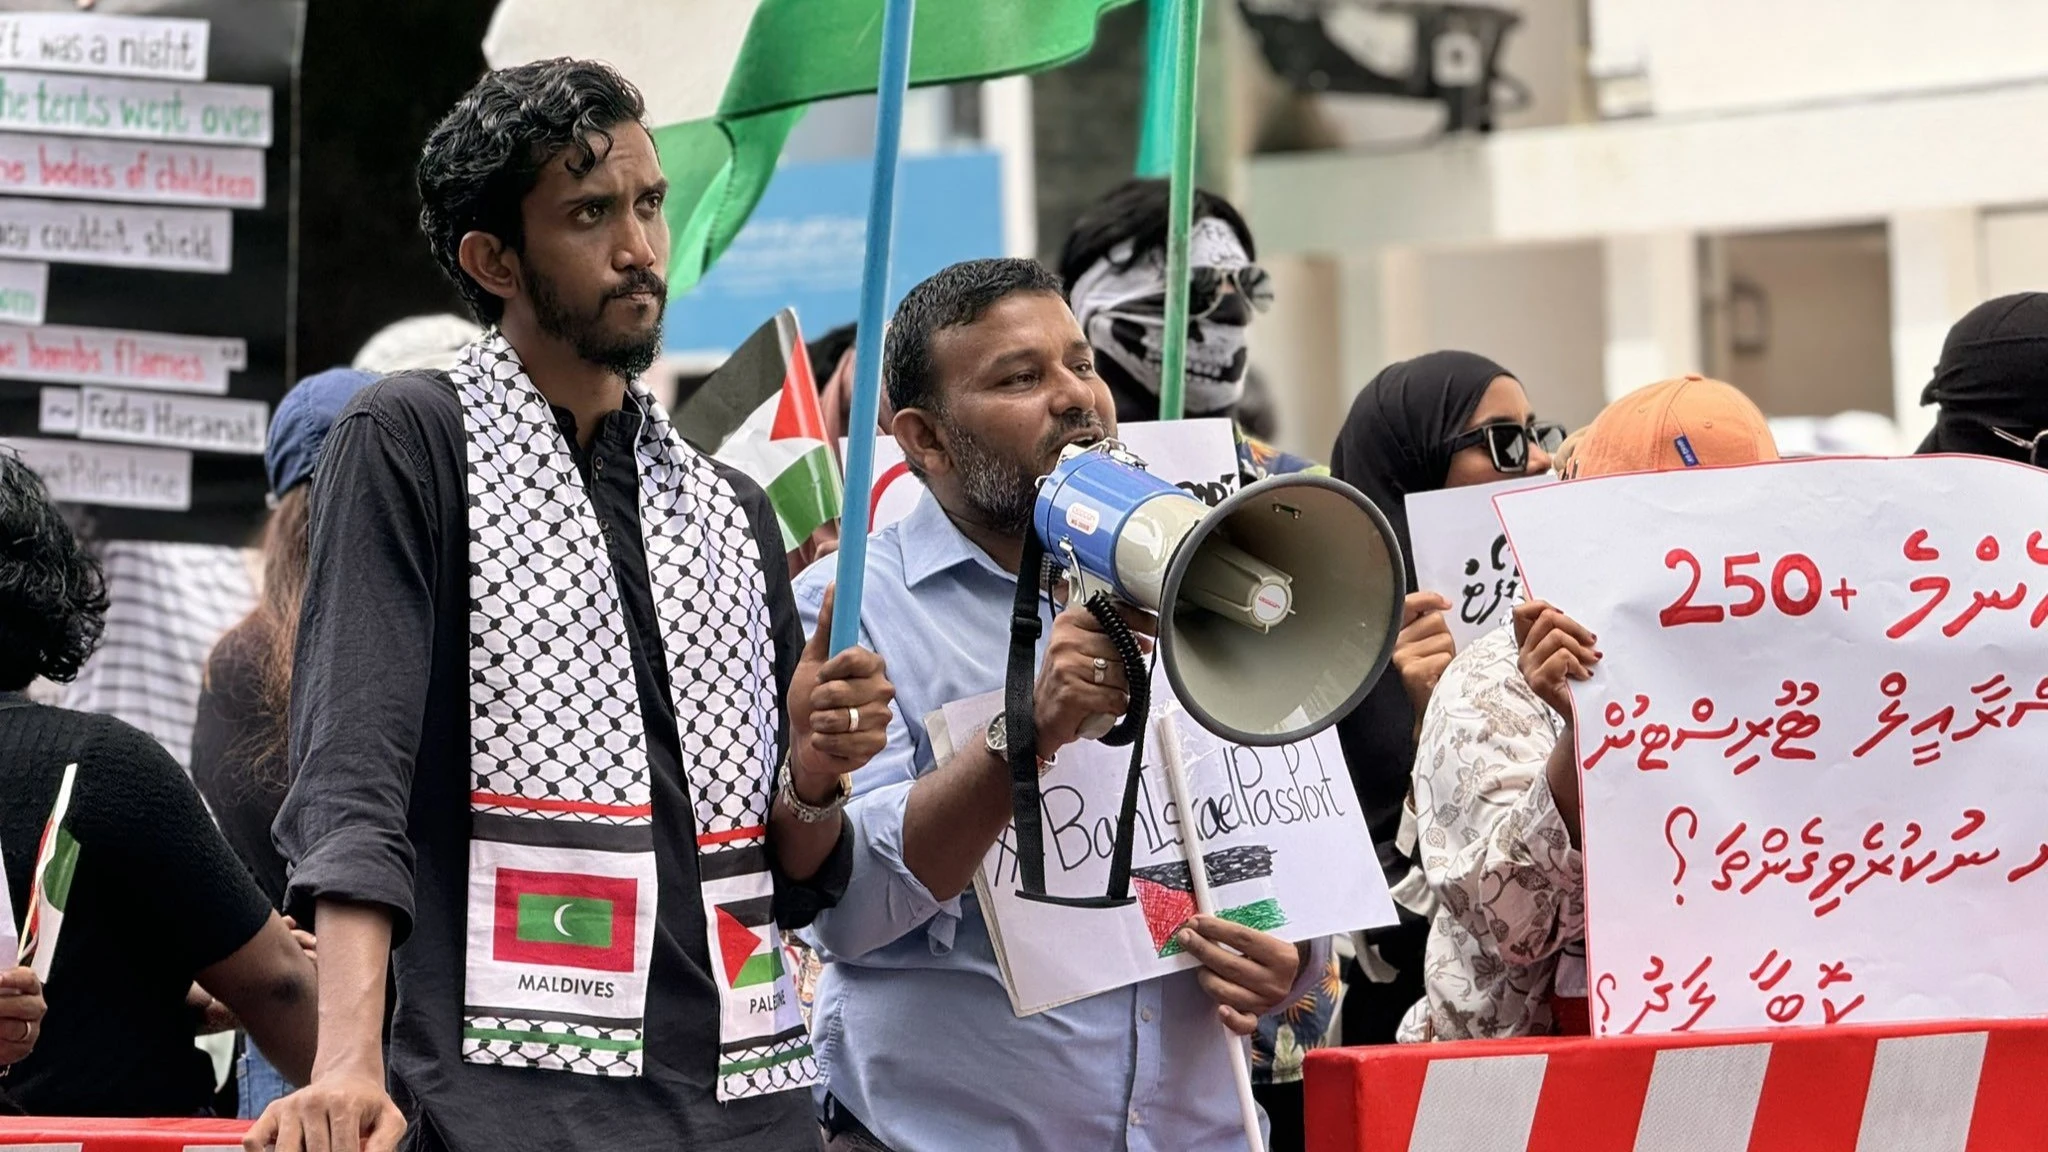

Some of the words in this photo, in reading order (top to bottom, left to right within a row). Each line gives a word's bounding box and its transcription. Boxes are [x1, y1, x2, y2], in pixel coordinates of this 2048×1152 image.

[40, 33, 84, 62] was
[88, 34, 107, 64] a
[119, 28, 196, 71] night
[36, 79, 111, 127] tents
[120, 90, 189, 135] wept
[202, 104, 265, 137] over
[38, 144, 116, 188] bodies
[125, 150, 148, 189] of
[155, 155, 256, 198] children
[144, 219, 213, 260] shield
[26, 331, 102, 371] bombs
[1659, 548, 1857, 627] 250+
[518, 974, 615, 999] MALDIVES
